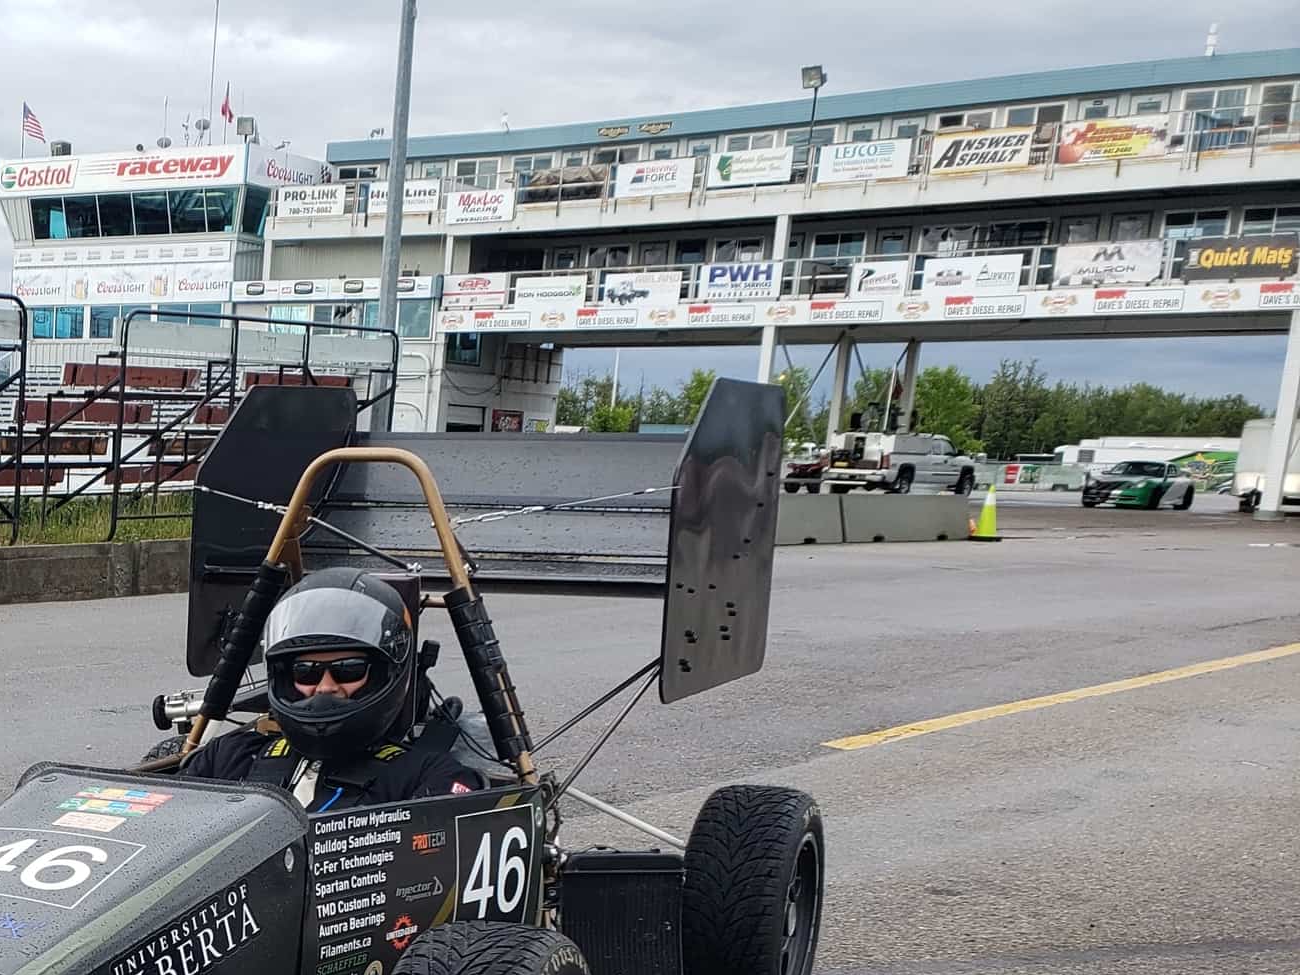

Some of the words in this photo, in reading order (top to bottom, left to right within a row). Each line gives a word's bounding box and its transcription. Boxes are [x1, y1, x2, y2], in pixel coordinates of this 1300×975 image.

[932, 134, 1029, 168] ANSWER
[18, 163, 71, 187] Castrol
[116, 154, 235, 177] raceway
[645, 171, 677, 182] FORCE
[292, 172, 313, 185] LIGHT
[405, 187, 437, 198] Line
[1200, 248, 1248, 268] Quick
[1250, 245, 1293, 266] Mats
[708, 264, 773, 283] PWH
[1077, 264, 1136, 275] MILRON
[123, 284, 145, 293] LIGHT
[205, 280, 229, 290] LIGHT
[315, 816, 347, 835] Control
[347, 813, 368, 829] Flow
[369, 808, 411, 827] Hydraulics
[314, 838, 347, 855] Bulldog
[348, 829, 401, 849] Sandblasting
[314, 859, 338, 875] C-Fer
[340, 849, 394, 868] Technologies
[462, 826, 528, 919] 46
[228, 884, 248, 907] OF
[315, 878, 350, 897] Spartan
[351, 871, 387, 888] Controls
[316, 903, 337, 919] TMD
[337, 896, 370, 913] Custom
[371, 892, 386, 906] Fab
[318, 922, 348, 938] Aurora
[350, 911, 386, 930] Bearings
[320, 936, 372, 960] Filaments.ca
